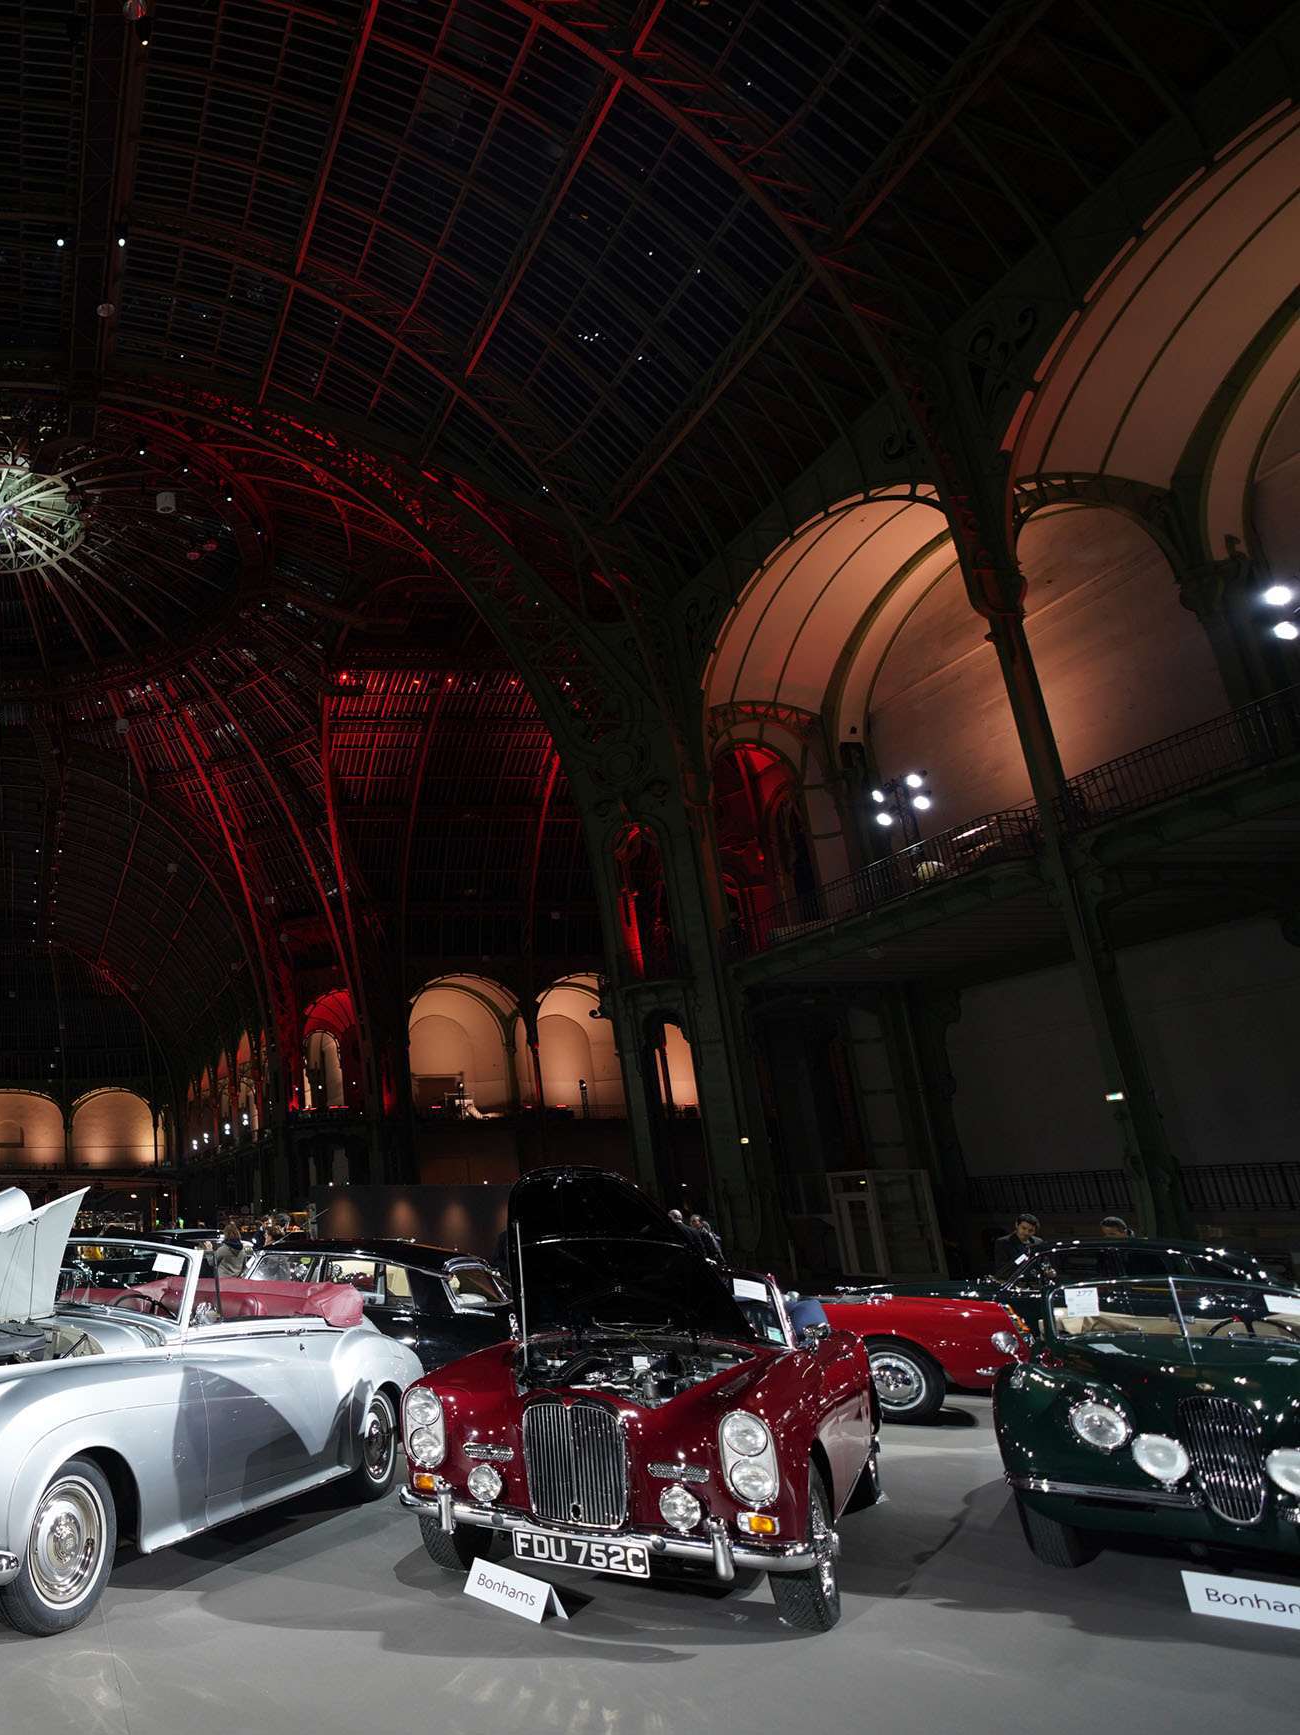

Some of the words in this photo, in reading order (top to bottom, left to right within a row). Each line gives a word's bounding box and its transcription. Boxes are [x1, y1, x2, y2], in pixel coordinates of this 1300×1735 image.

[515, 1533, 568, 1562] FDU
[571, 1541, 646, 1573] 752C
[477, 1573, 537, 1607] Bonhams
